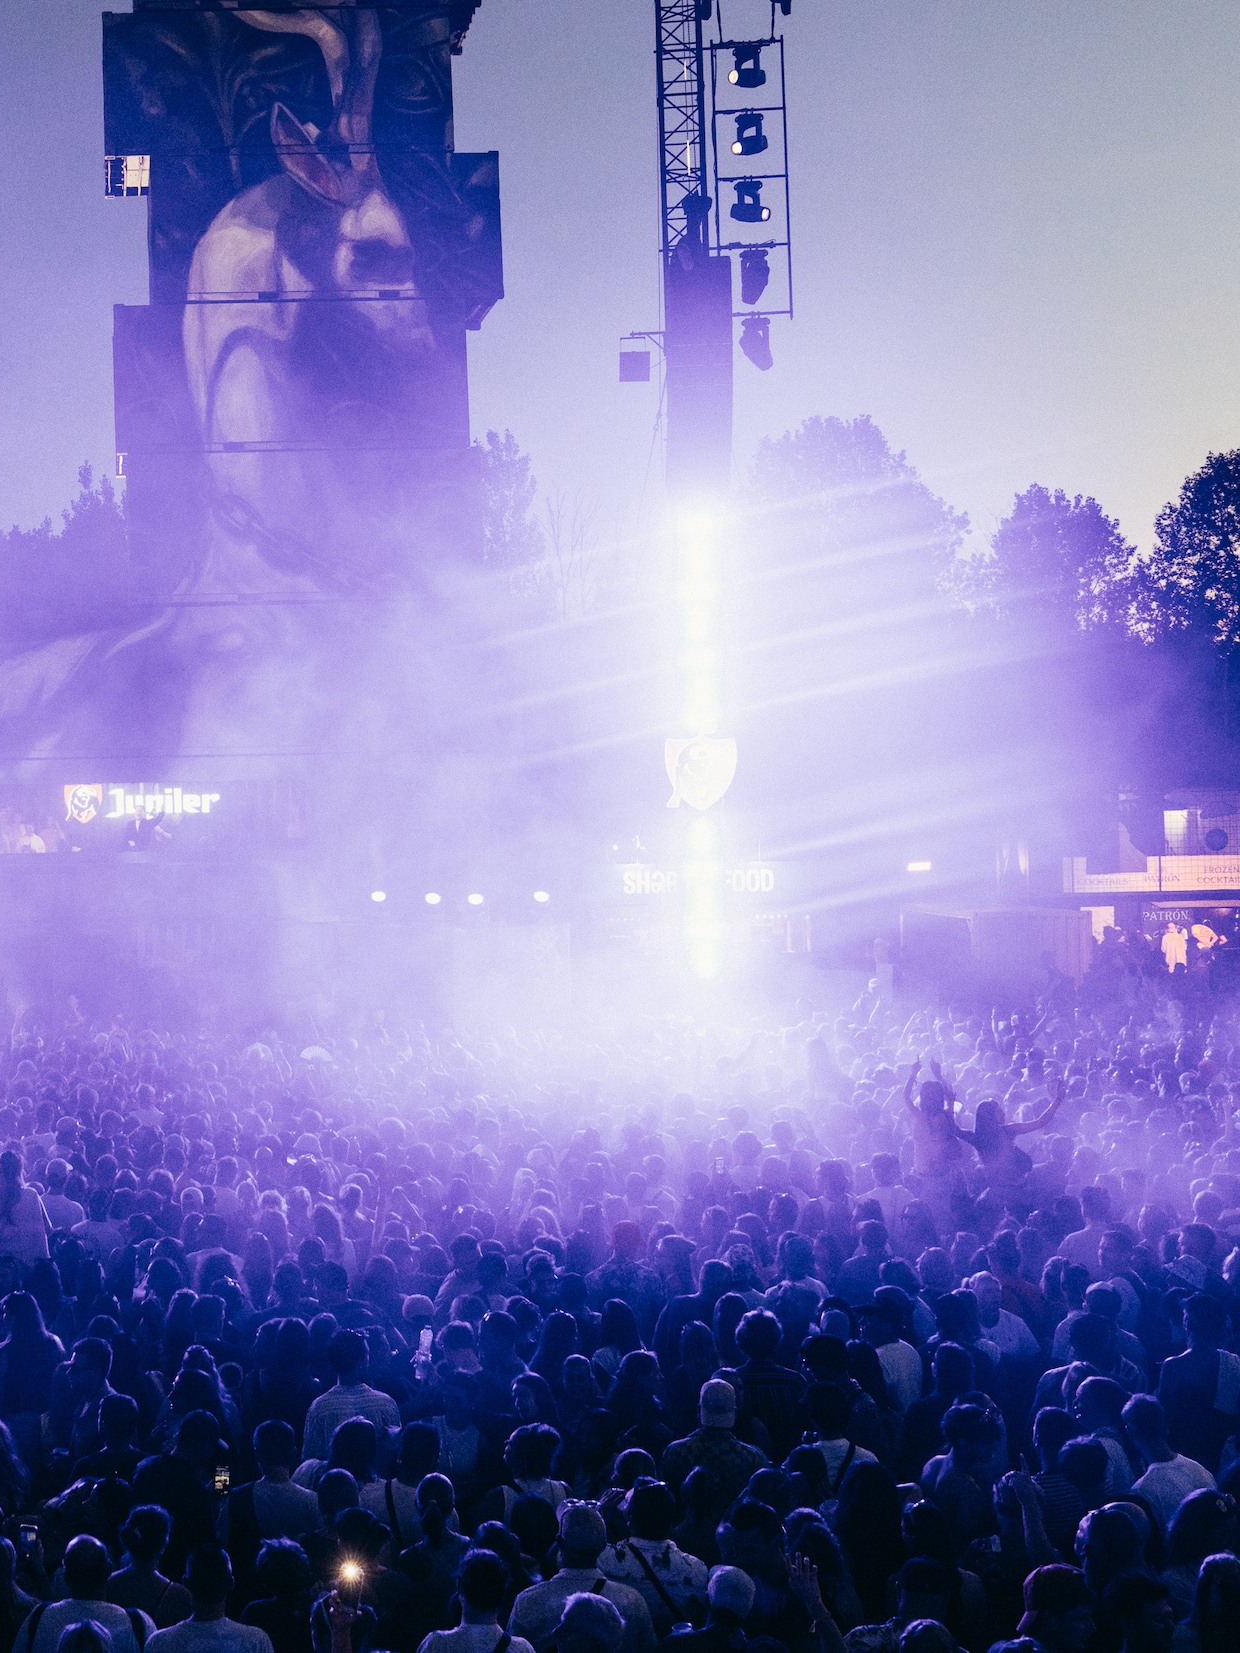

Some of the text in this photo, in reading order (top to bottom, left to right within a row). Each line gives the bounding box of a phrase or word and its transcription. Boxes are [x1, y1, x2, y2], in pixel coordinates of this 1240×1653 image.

[105, 787, 220, 820] Jupiler
[1203, 866, 1240, 874] FROZEN
[1142, 908, 1189, 921] PATRÓN
